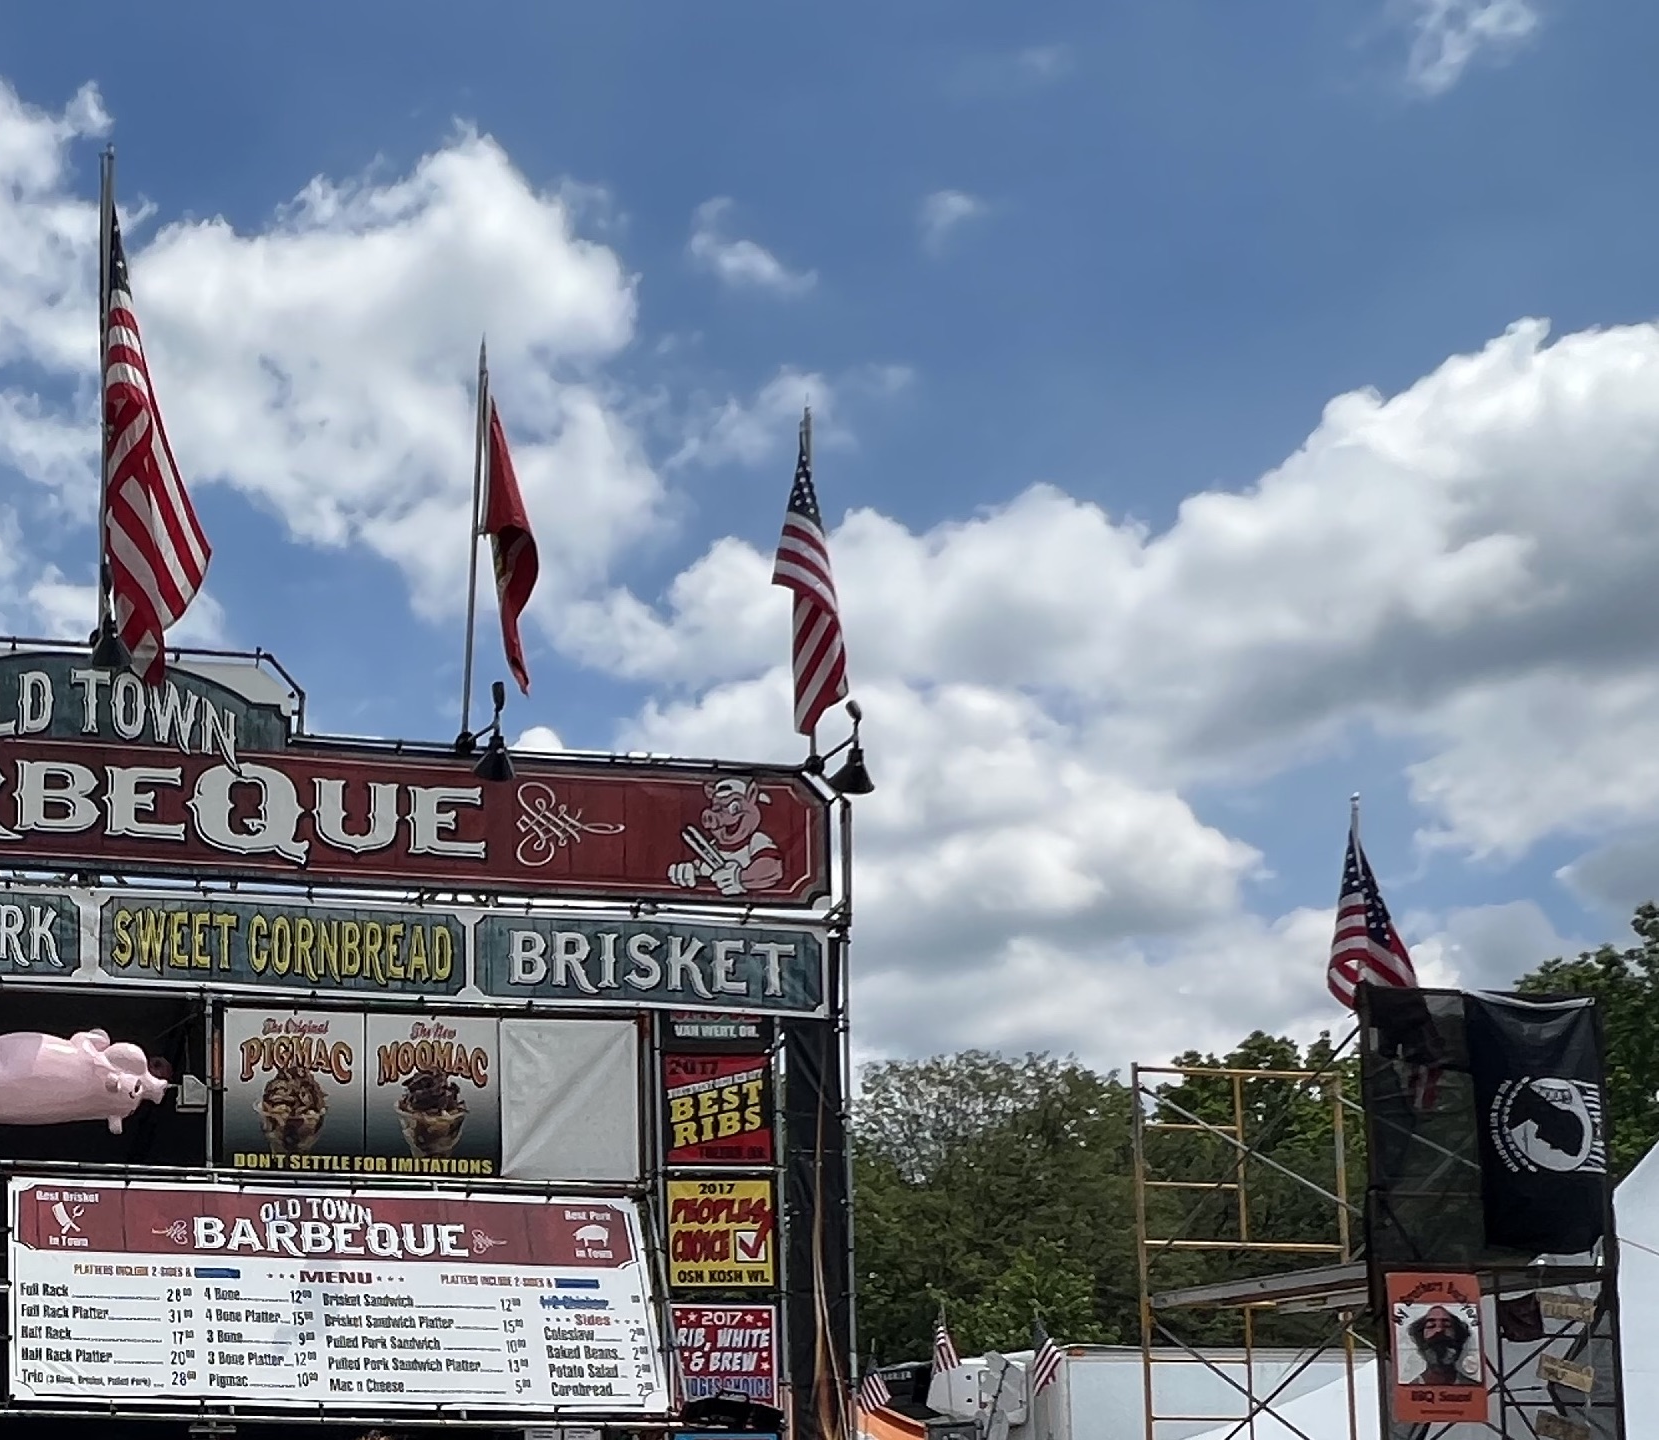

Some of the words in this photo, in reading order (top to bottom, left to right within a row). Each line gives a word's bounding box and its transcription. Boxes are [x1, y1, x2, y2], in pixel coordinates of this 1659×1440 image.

[70, 667, 241, 772] TOWN
[112, 908, 240, 972] SWEET
[246, 913, 455, 991] CORNBREAD
[507, 929, 799, 1001] BRISKET
[673, 1024, 699, 1038] VAN
[240, 1034, 354, 1086] PIGMAC
[376, 1039, 490, 1088] MOOMAC
[670, 1079, 764, 1124] BEST
[673, 1105, 762, 1148] RIBS
[233, 1152, 286, 1169] DON'T
[289, 1153, 351, 1172] SETTLE
[353, 1155, 388, 1173] FOR
[391, 1156, 494, 1175] IMITATIONS
[35, 1190, 60, 1201] Best
[62, 1191, 99, 1203] Brisket
[697, 1182, 736, 1196] 2017
[260, 1198, 301, 1224] OLD
[304, 1199, 373, 1227] TOWN
[588, 1210, 613, 1222] Pork
[192, 1216, 470, 1259] BARBEQUE
[299, 1270, 373, 1285] MENU
[677, 1269, 705, 1284] OSH
[708, 1269, 744, 1284] KOSH
[42, 1283, 69, 1297] Rack
[214, 1287, 241, 1301] Bone
[363, 1293, 414, 1308] Sandwich
[43, 1304, 70, 1318] Rack
[71, 1305, 109, 1320] Platter
[215, 1308, 242, 1323] Bone
[245, 1309, 281, 1324] Platter
[573, 1313, 611, 1326] Sides
[700, 1310, 744, 1326] 2017
[365, 1314, 417, 1329] Sandwich
[418, 1315, 455, 1329] Platter
[44, 1325, 72, 1340] Rack
[206, 1329, 214, 1344] 3
[217, 1329, 243, 1344] Bone
[676, 1327, 712, 1351] RIB,
[716, 1327, 771, 1349] WHITE
[326, 1335, 359, 1349] Pulled
[361, 1335, 387, 1350] Pork
[390, 1336, 442, 1351] Sandwich
[45, 1348, 73, 1362] Rack
[75, 1348, 113, 1364] Platter
[207, 1350, 215, 1365] 3
[218, 1351, 245, 1366] Bone
[247, 1351, 284, 1366] Platter
[546, 1344, 581, 1360] Baked
[584, 1345, 618, 1360] Beans
[328, 1356, 361, 1371] Pulled
[363, 1356, 390, 1371] Pork
[392, 1357, 443, 1372] Sandwich
[445, 1358, 481, 1373] Platter
[689, 1352, 705, 1373] &
[708, 1351, 759, 1373] BREW
[22, 1368, 44, 1384] Trio
[548, 1363, 585, 1379] Potato
[587, 1364, 619, 1378] Salad
[208, 1373, 249, 1390] Pigmac
[329, 1378, 353, 1392] Mac
[366, 1379, 405, 1393] Cheese
[551, 1382, 614, 1397] Cornbread
